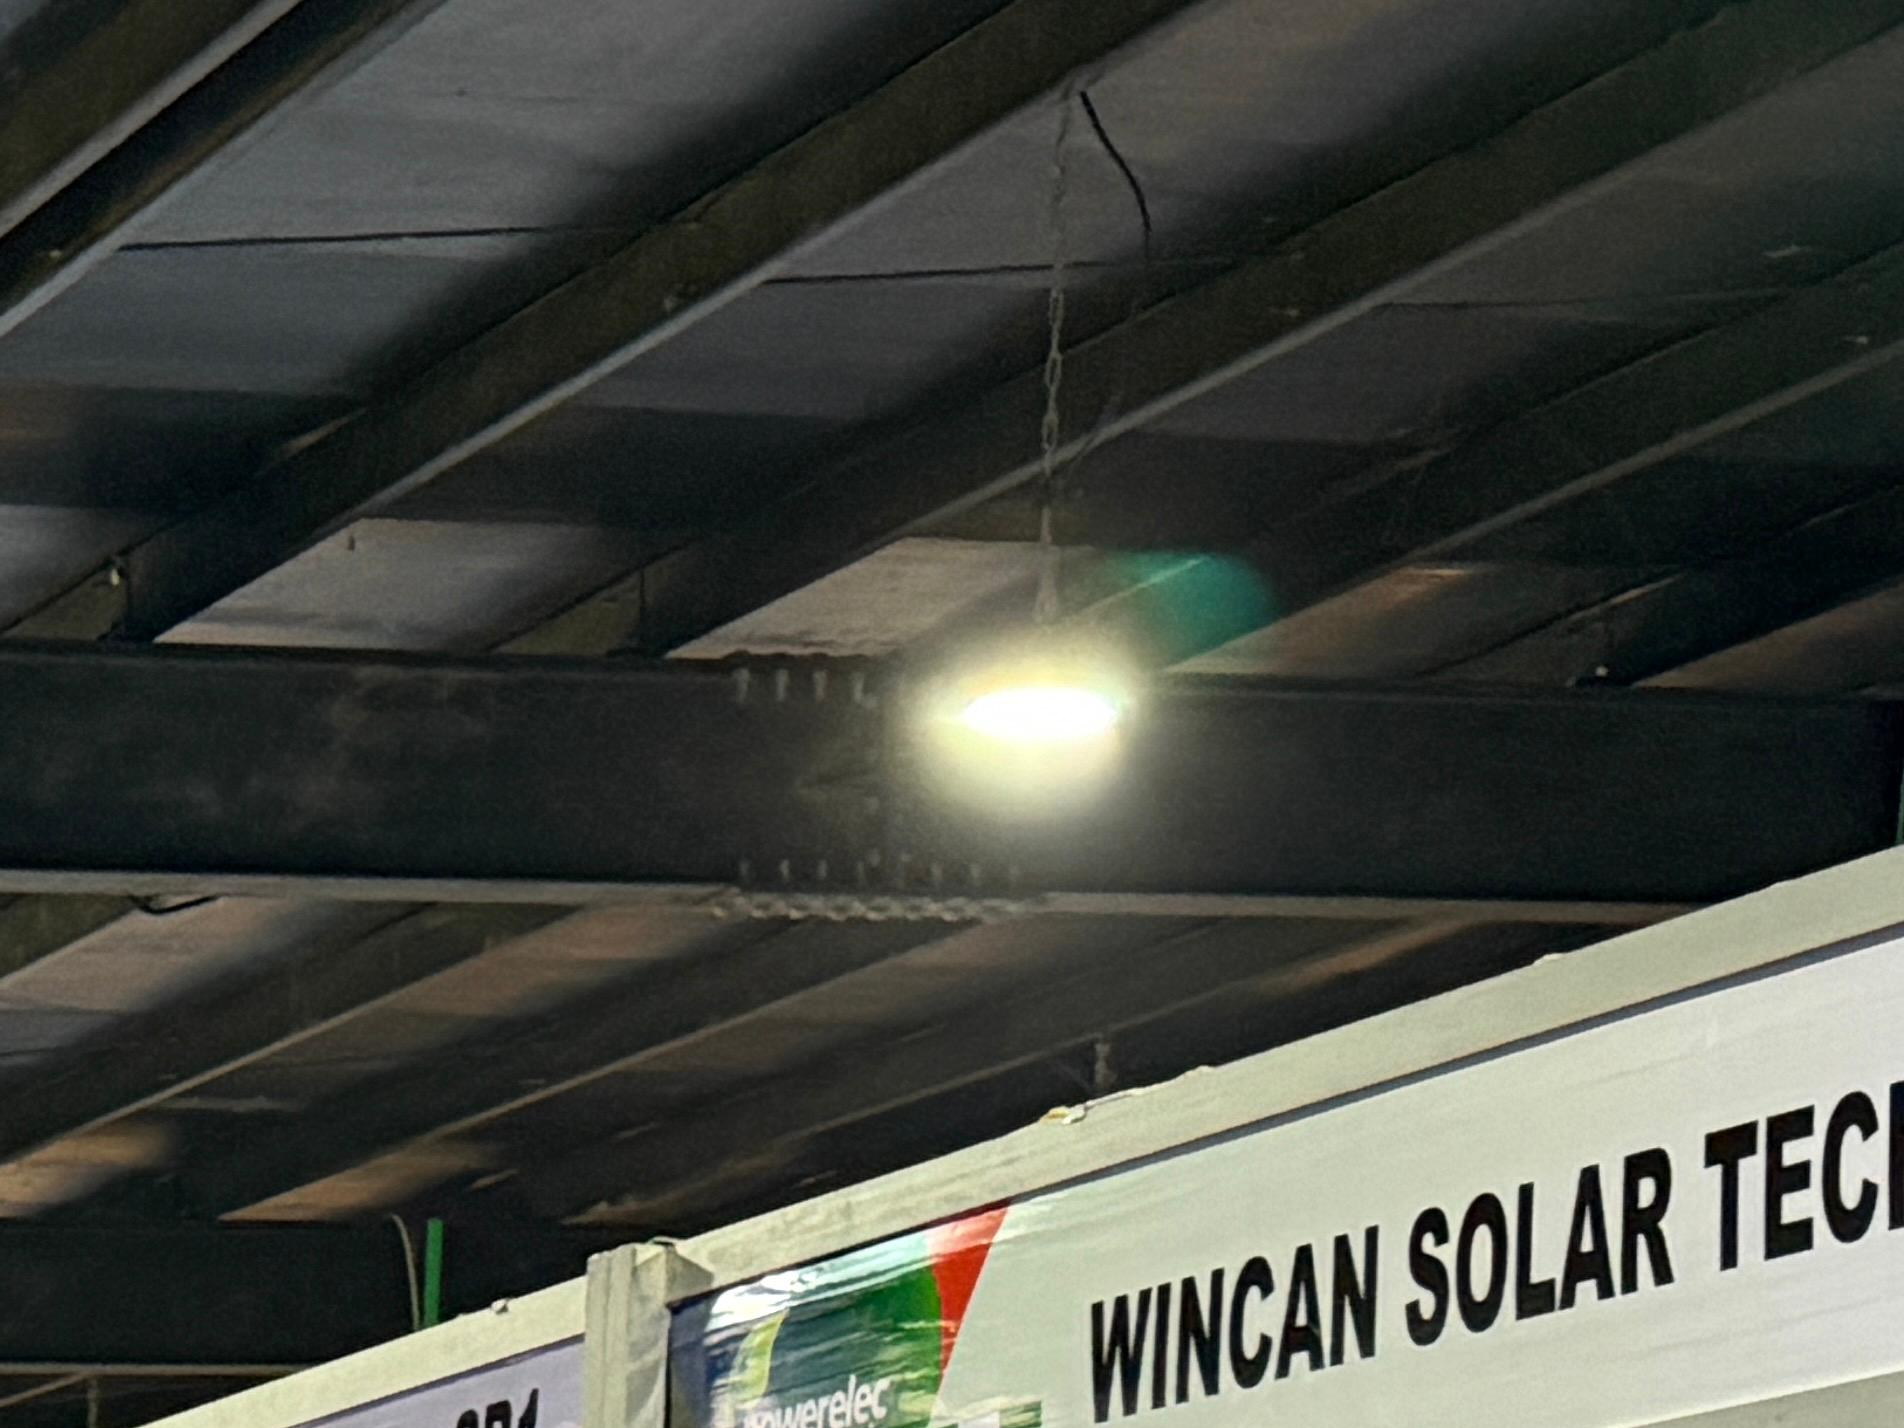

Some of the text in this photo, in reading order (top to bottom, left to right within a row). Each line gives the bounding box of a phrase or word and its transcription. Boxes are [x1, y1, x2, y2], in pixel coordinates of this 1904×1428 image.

[1091, 1080, 1904, 1424] WINCAN SOLAR TEC
